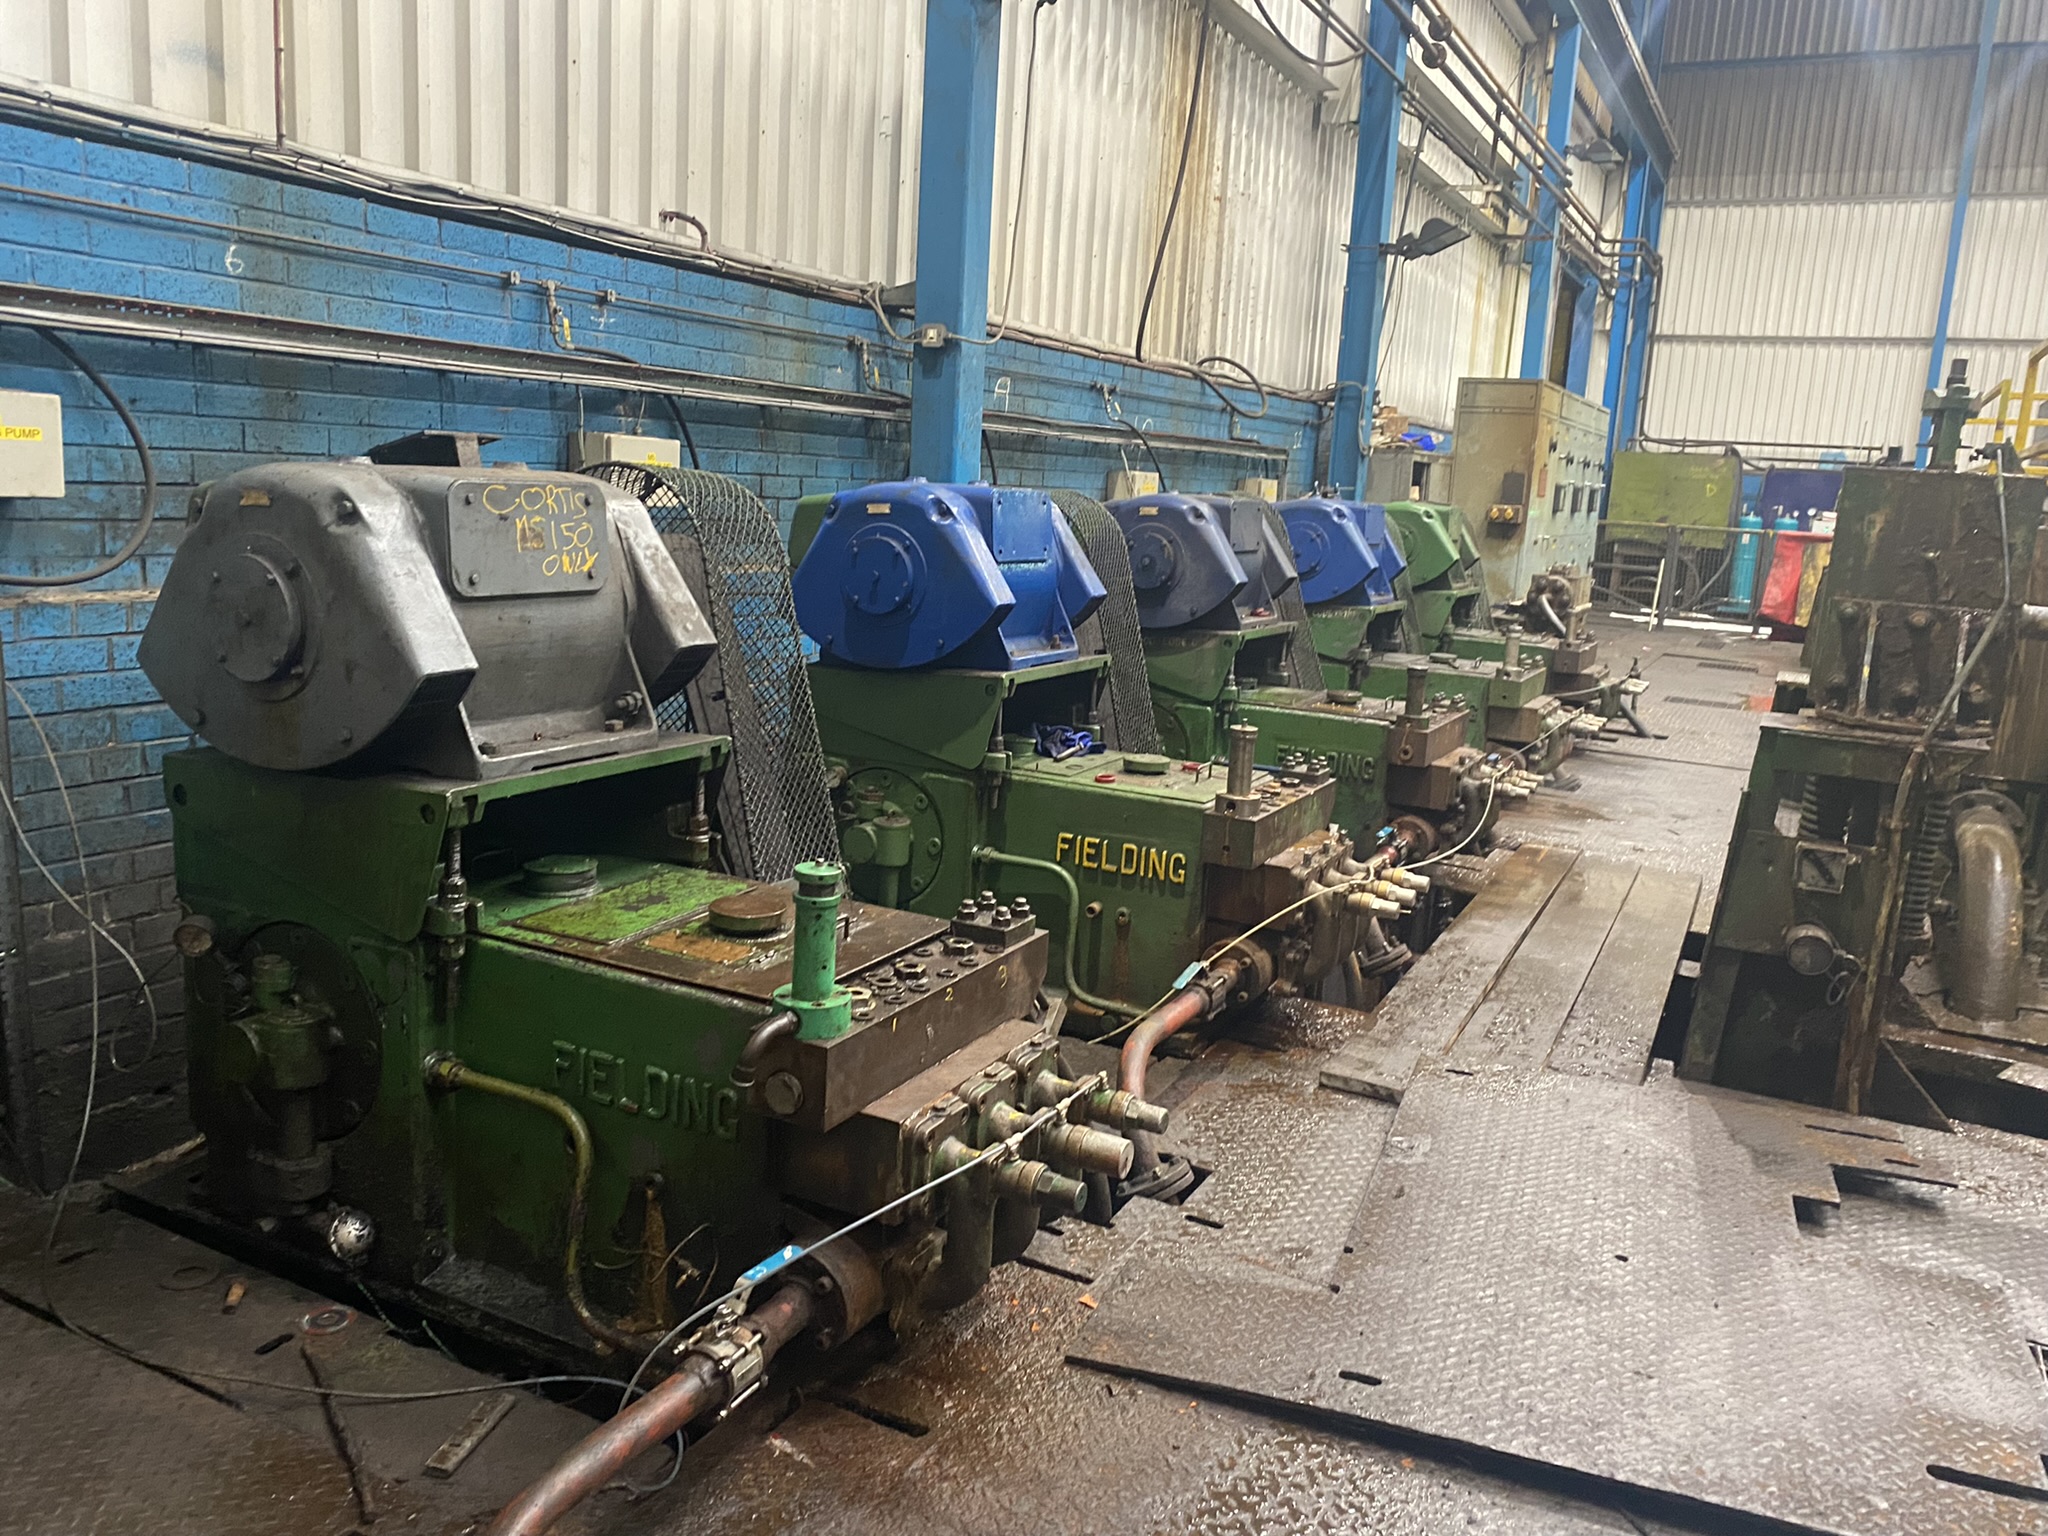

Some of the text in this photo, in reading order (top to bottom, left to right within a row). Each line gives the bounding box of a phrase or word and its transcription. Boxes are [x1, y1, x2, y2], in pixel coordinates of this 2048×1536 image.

[224, 244, 245, 275] 6
[5, 427, 40, 439] PUMP
[551, 521, 593, 551] 150
[542, 547, 599, 577] ONLY
[1056, 832, 1186, 884] FIELDING
[945, 987, 954, 1001] 2
[998, 965, 1008, 988] 3
[552, 1039, 739, 1140] FIELDING
